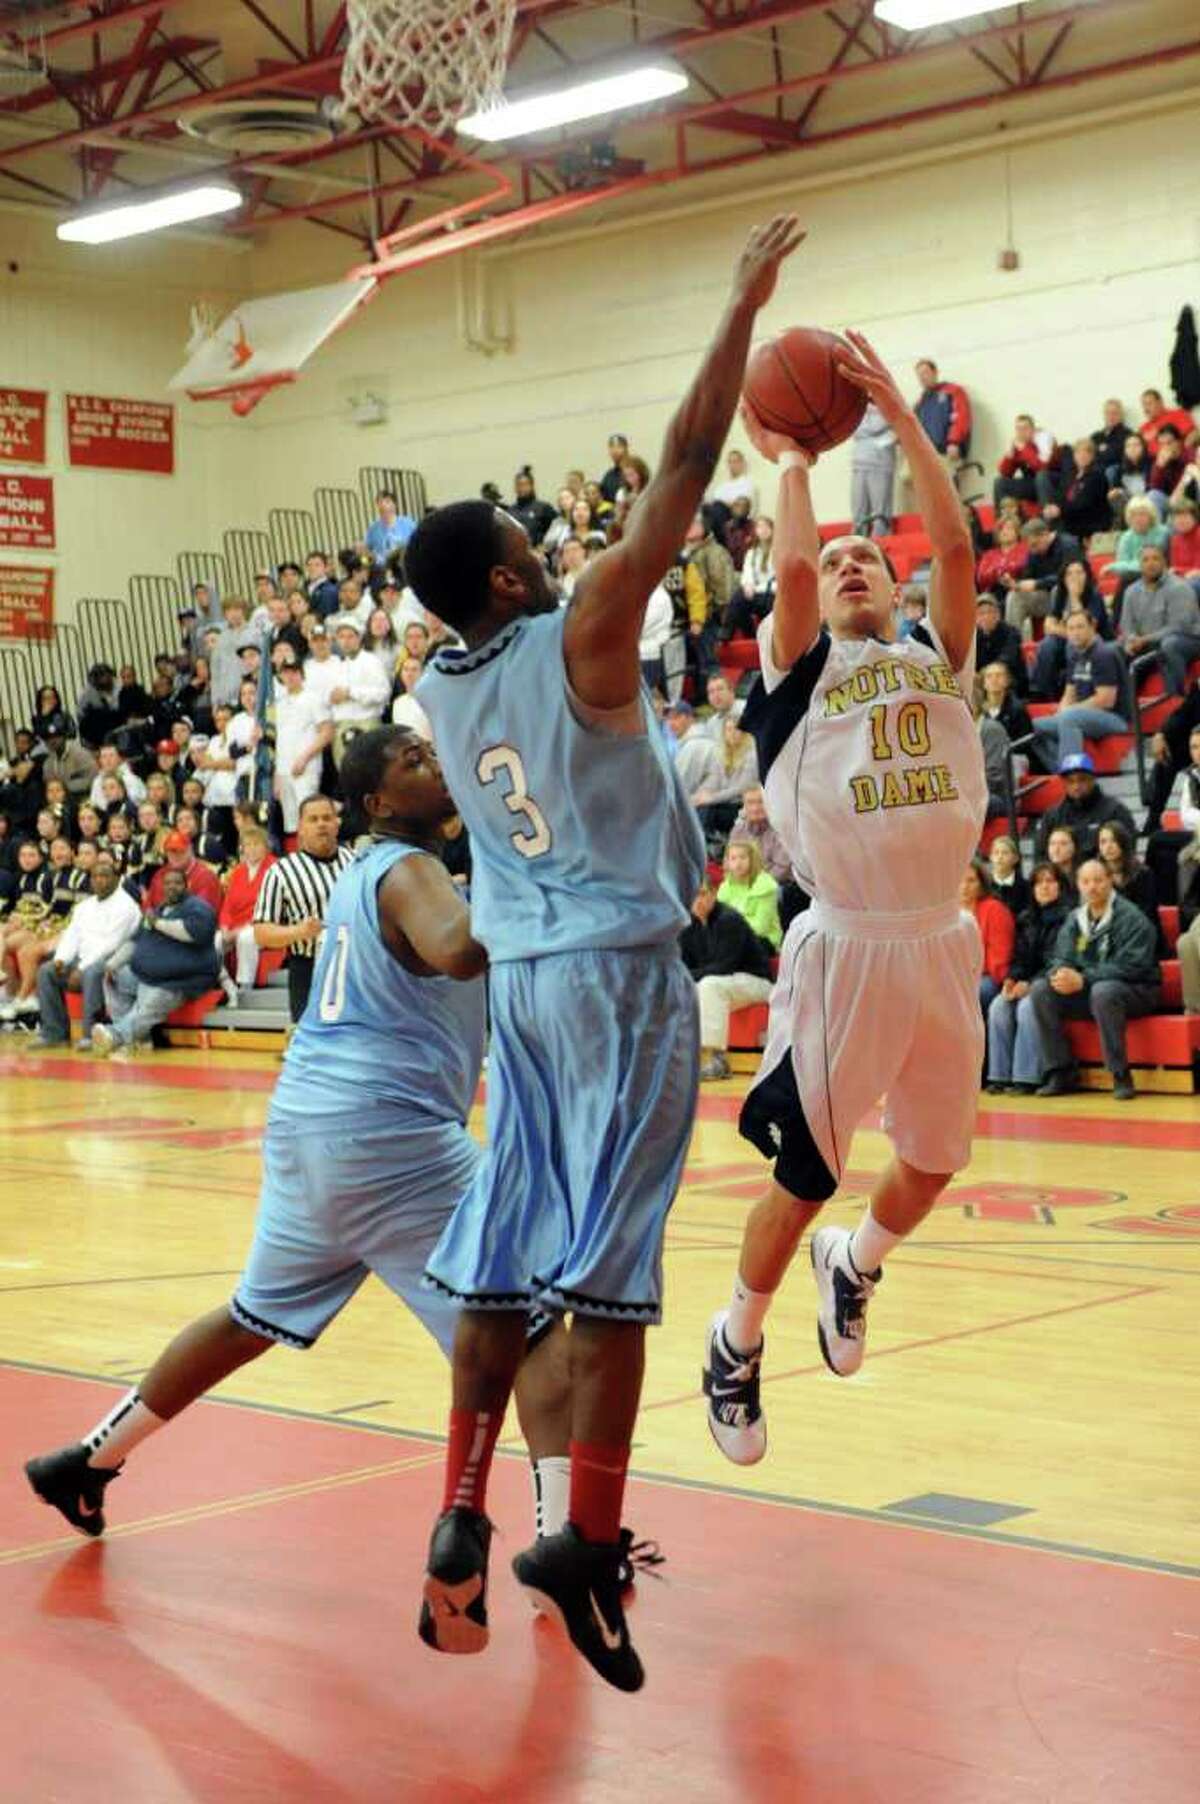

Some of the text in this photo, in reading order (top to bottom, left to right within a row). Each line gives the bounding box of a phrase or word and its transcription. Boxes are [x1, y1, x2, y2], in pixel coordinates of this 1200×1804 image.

[825, 659, 962, 718] NOTRE
[870, 702, 931, 760] 10
[476, 744, 551, 860] 3
[850, 765, 960, 814] DAME
[319, 923, 350, 1024] 0
